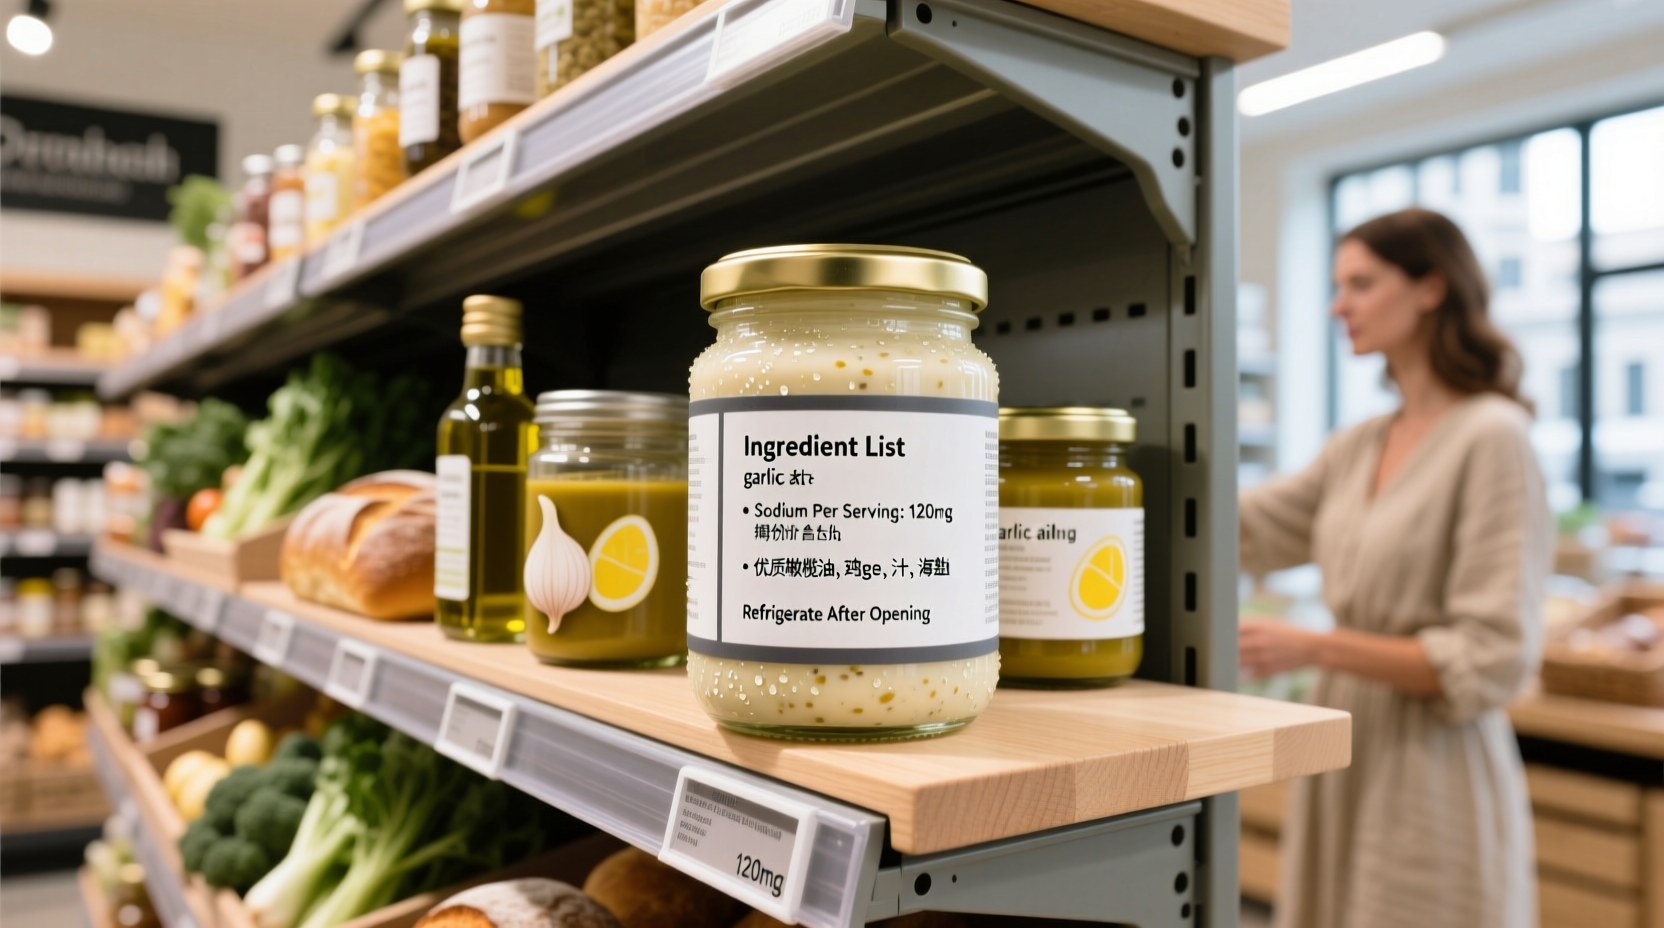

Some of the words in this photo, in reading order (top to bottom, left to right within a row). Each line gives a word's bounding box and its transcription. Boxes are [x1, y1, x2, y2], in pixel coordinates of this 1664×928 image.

[744, 434, 858, 462] Ingredient
[865, 435, 906, 458] List
[743, 467, 785, 489] garlic
[754, 501, 808, 518] Sodium
[812, 503, 839, 518] Per
[842, 502, 905, 524] Serving:
[909, 503, 953, 523] 120mg
[742, 604, 823, 625] Refrigerate
[827, 605, 866, 622] After
[870, 604, 931, 625] Opening
[736, 853, 784, 898] 120mg
